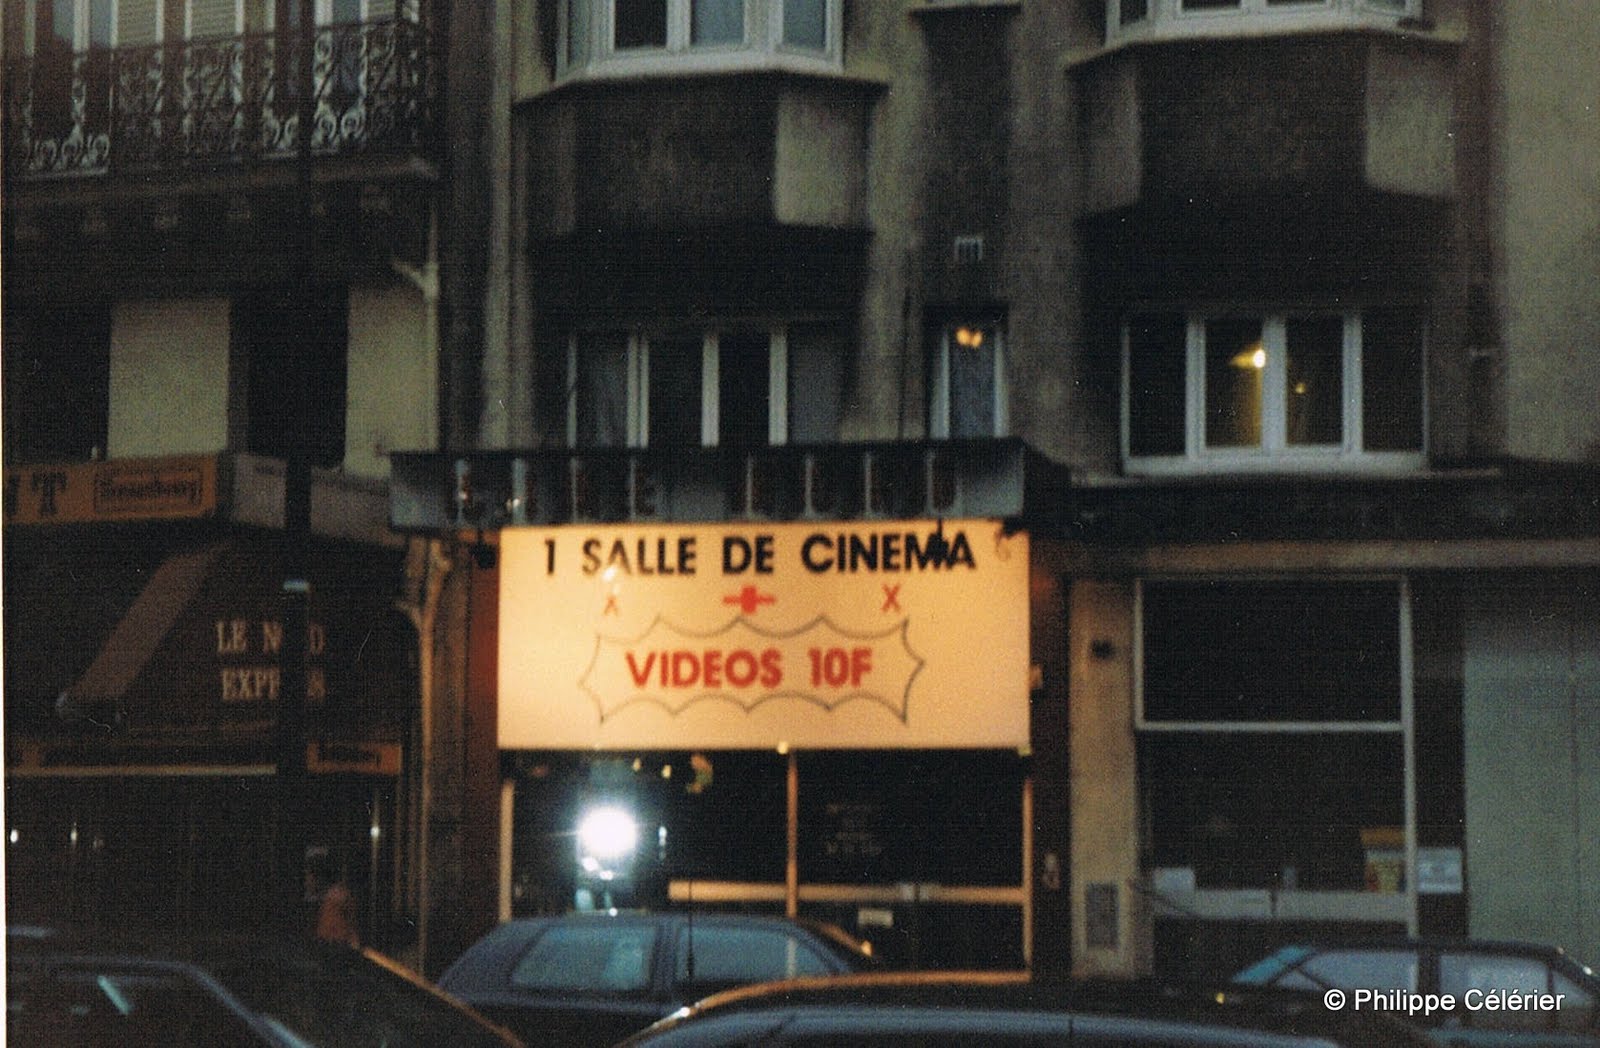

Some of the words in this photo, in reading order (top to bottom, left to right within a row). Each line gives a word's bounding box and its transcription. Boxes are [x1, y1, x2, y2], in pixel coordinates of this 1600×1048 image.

[543, 538, 557, 576] 1
[581, 535, 697, 575] SALLE
[722, 535, 775, 575] DE
[800, 531, 977, 574] CINEMA
[215, 620, 248, 654] LE
[262, 620, 326, 655] ND
[625, 650, 783, 688] VIDEOS
[810, 648, 873, 687] 10F
